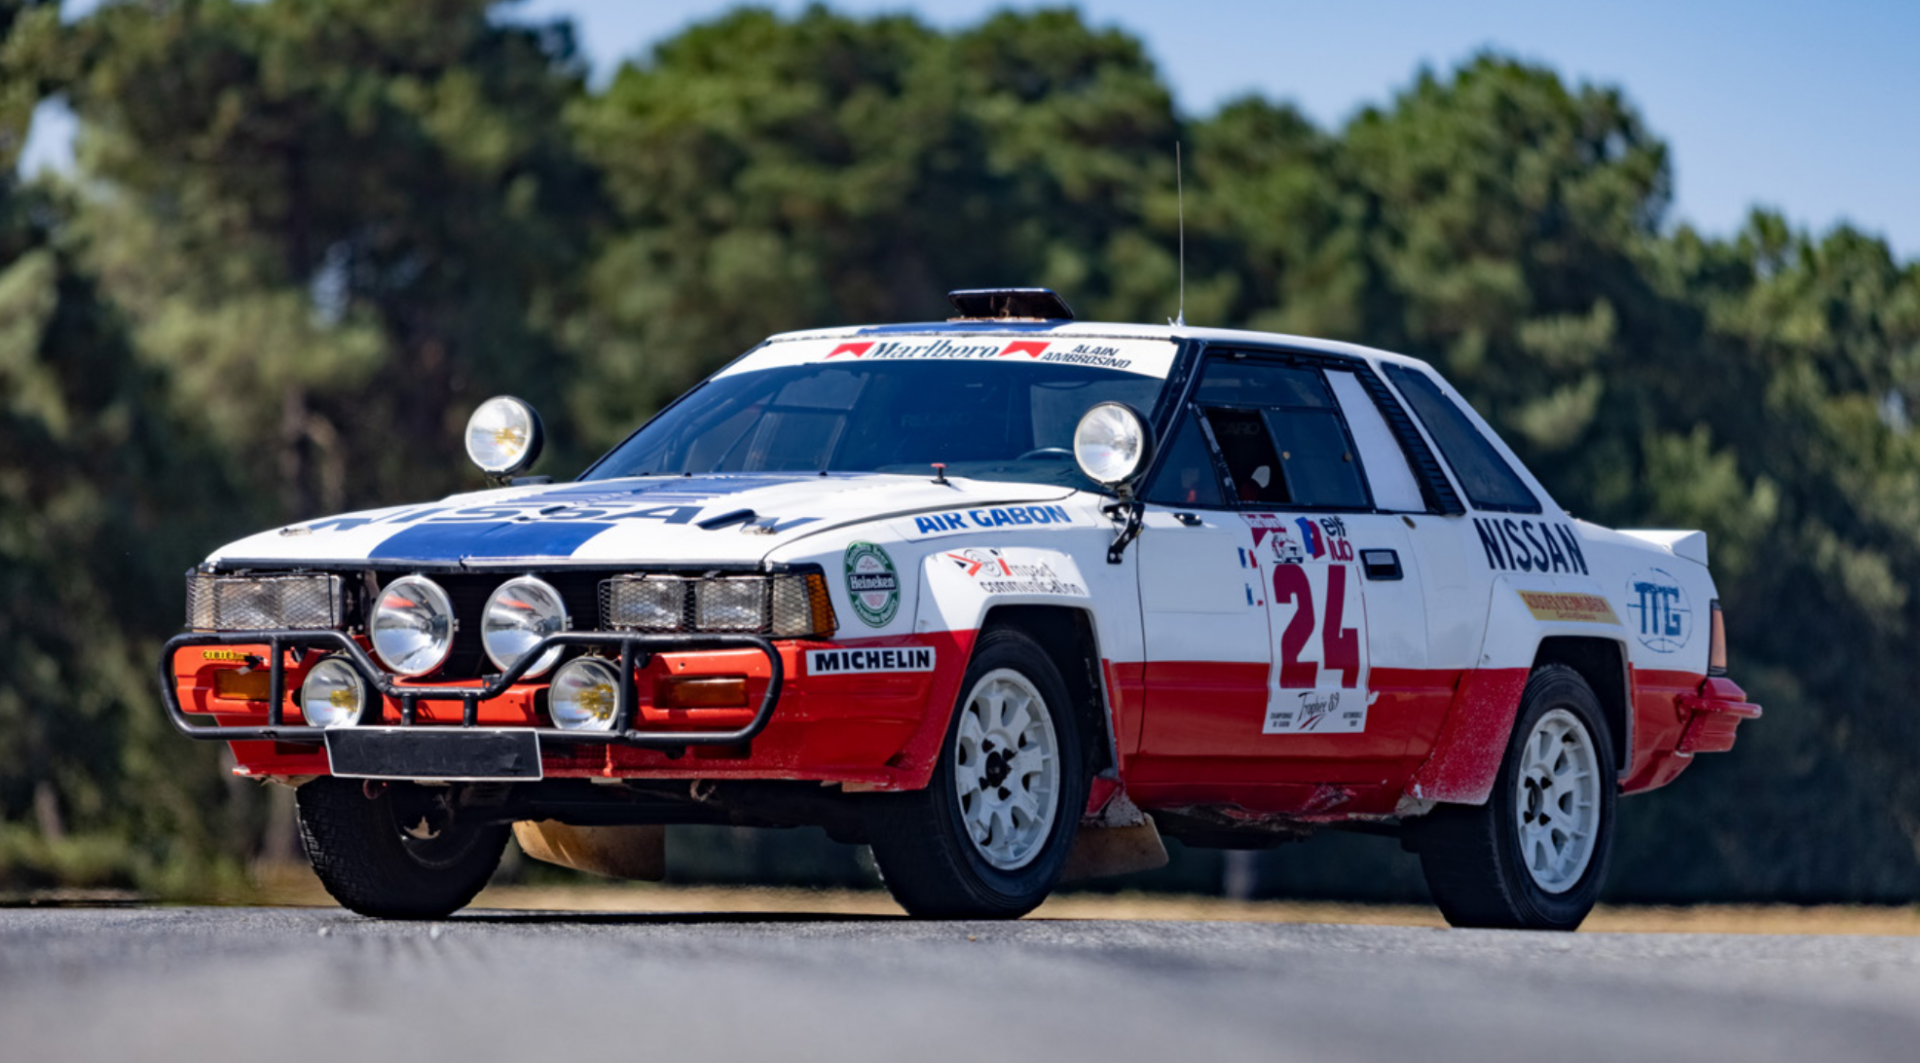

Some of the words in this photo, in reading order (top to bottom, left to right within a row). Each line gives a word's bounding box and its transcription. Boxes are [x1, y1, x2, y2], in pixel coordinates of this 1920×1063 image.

[868, 339, 1000, 360] Marlboro
[1041, 352, 1132, 368] AMBROSINO
[1071, 344, 1120, 356] ALAIN
[914, 512, 968, 534] AIR
[969, 505, 1072, 527] GABON
[1319, 515, 1346, 537] elf
[1326, 536, 1354, 562] lub
[1472, 517, 1589, 576] NISSAN
[850, 576, 895, 590] Heineken
[979, 579, 1086, 596] communication
[1273, 564, 1359, 689] 24
[815, 649, 930, 671] MICHELIN
